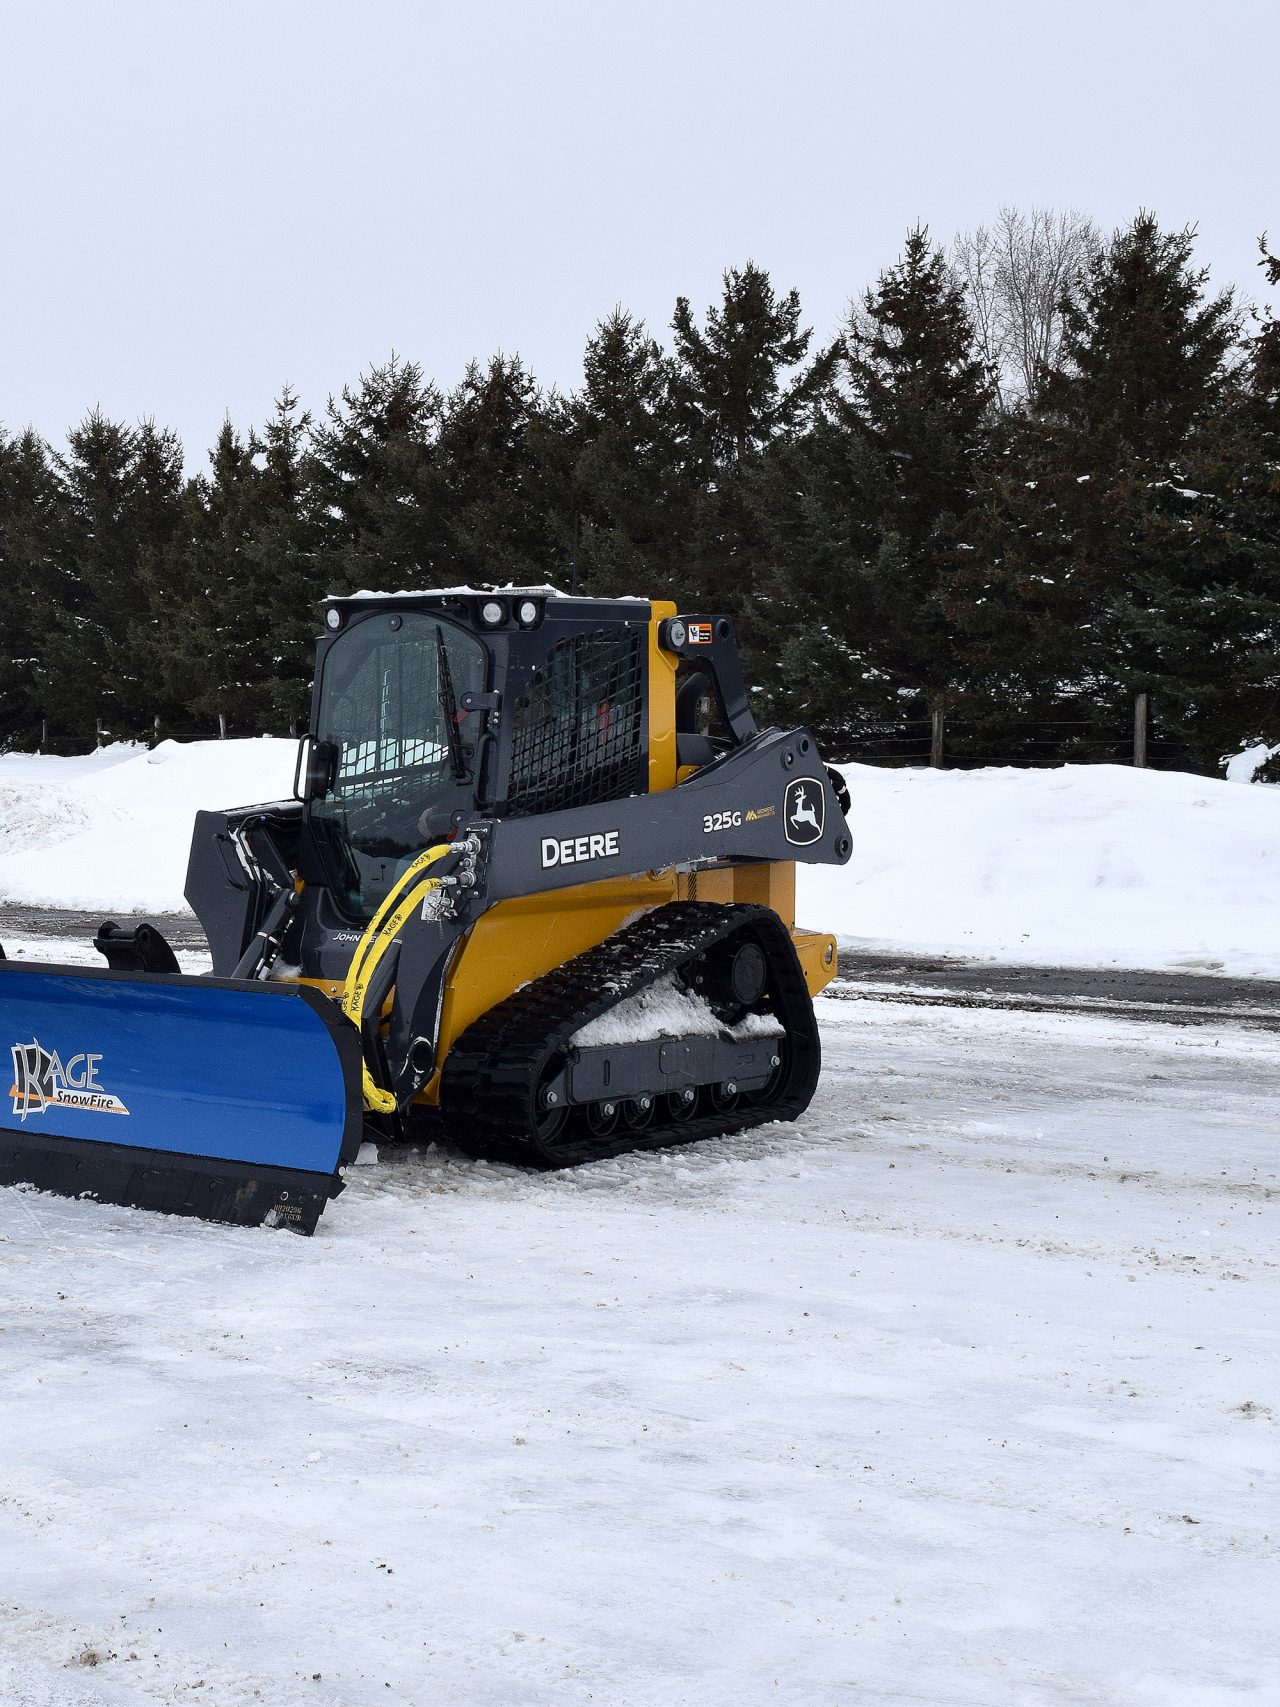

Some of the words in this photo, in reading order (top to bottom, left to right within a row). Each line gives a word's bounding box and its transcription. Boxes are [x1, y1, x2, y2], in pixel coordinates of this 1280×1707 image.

[703, 811, 742, 833] 325G
[542, 831, 619, 868] DEERE
[332, 932, 361, 942] JOHN
[16, 1037, 105, 1123] KAGE
[56, 1090, 114, 1109] SnowFire
